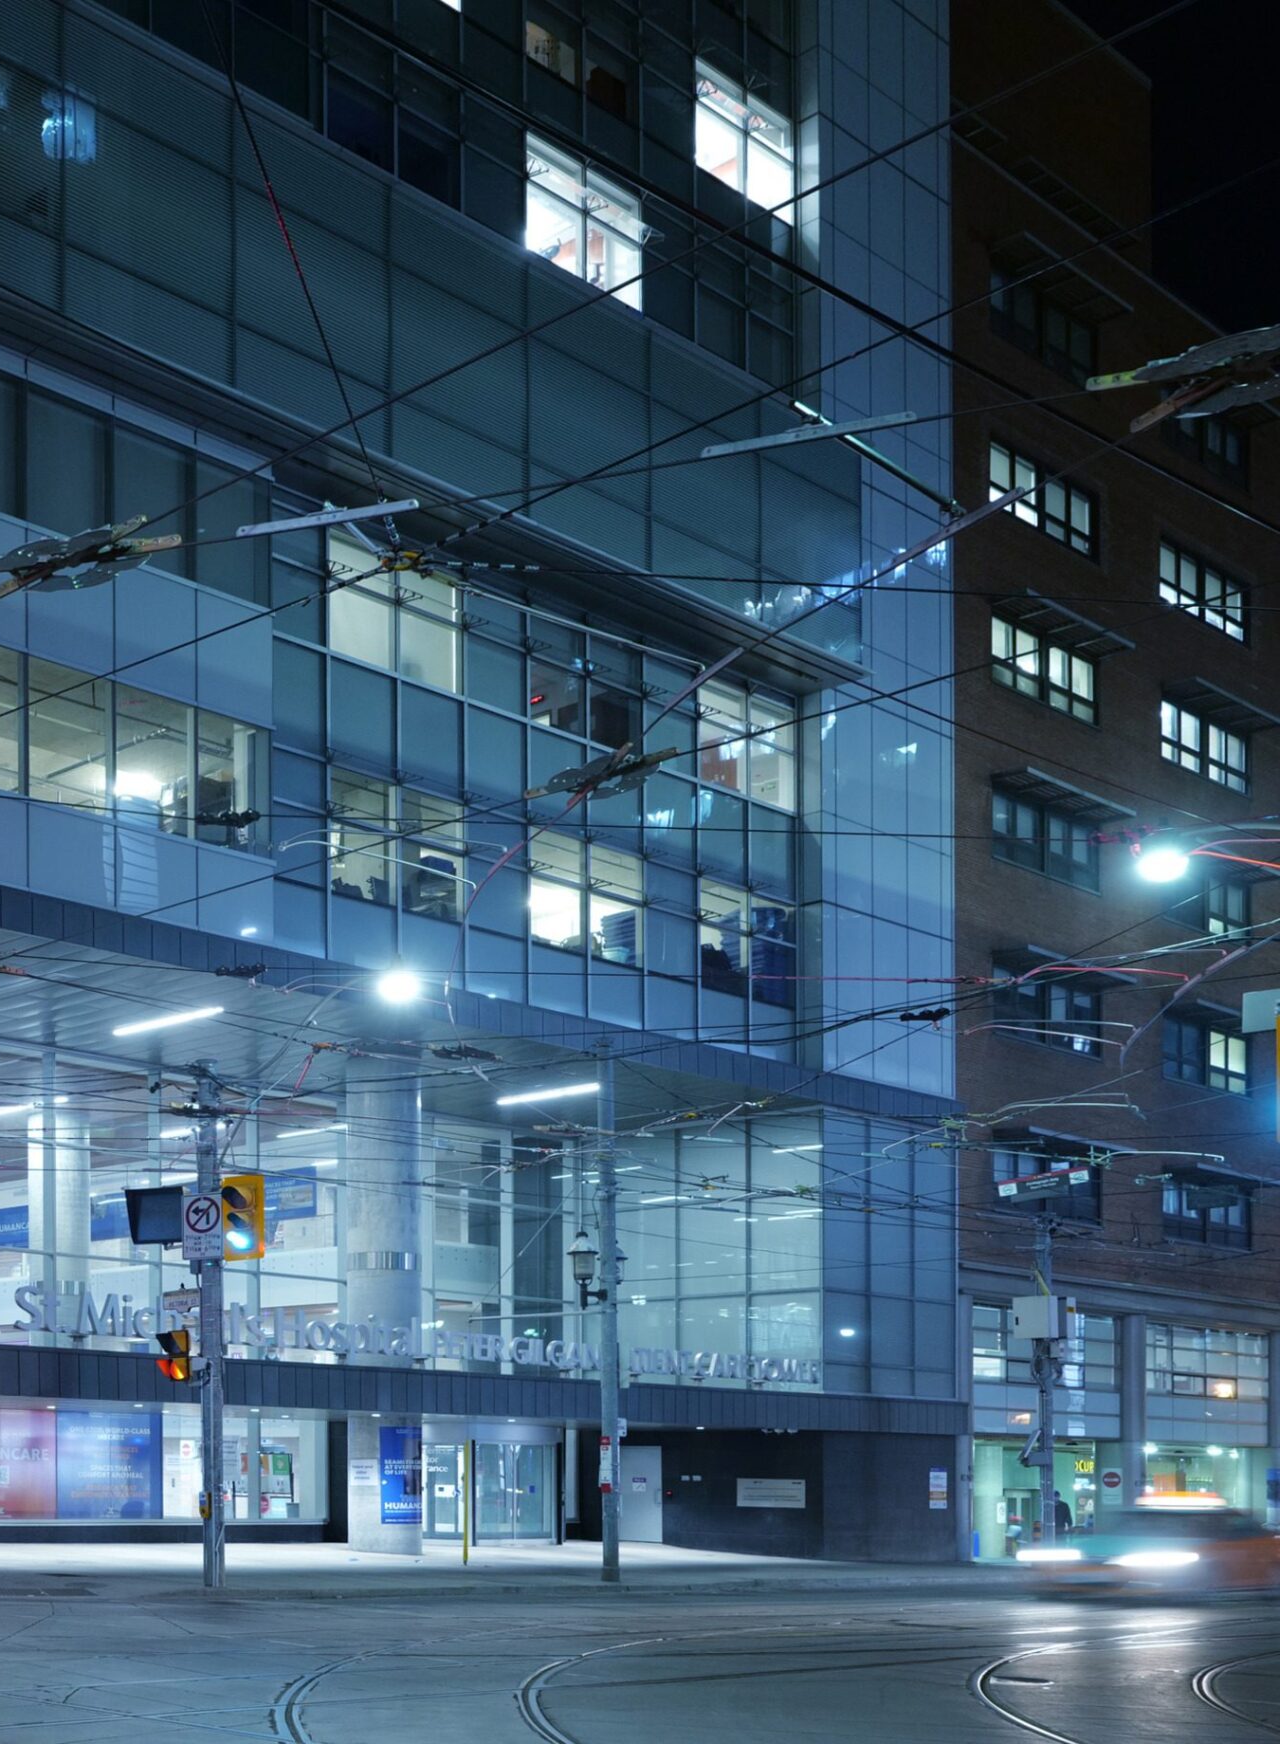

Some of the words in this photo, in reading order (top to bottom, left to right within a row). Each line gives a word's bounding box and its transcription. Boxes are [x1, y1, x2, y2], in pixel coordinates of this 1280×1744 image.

[14, 1285, 73, 1333] St.
[77, 1290, 266, 1346] Michal's
[274, 1307, 420, 1364] Hospital
[432, 1331, 511, 1363] PETER
[510, 1337, 601, 1370] GILGAN
[750, 1356, 820, 1384] TOWER
